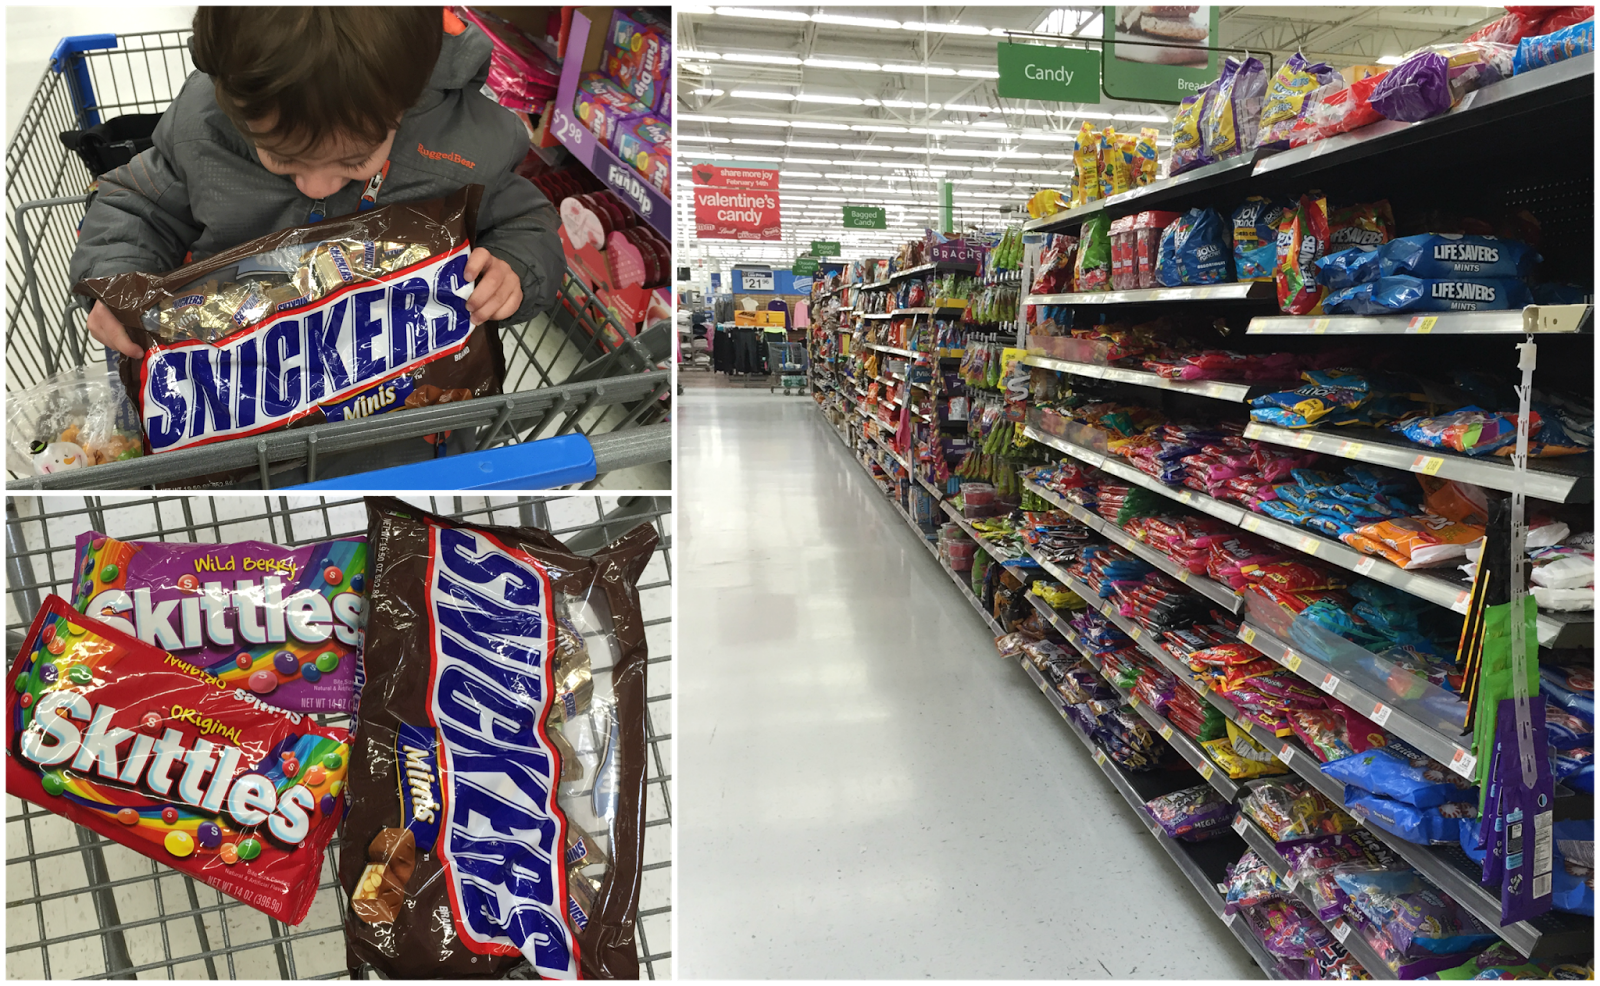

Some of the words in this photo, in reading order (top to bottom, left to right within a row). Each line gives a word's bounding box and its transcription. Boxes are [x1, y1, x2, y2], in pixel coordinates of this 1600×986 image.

[1024, 64, 1074, 86] Candy
[417, 143, 476, 170] RuggedBear
[720, 169, 742, 177] share
[762, 170, 774, 180] joy
[726, 179, 754, 187] February
[698, 192, 776, 209] valentine's
[717, 208, 763, 226] candy
[851, 210, 877, 220] Bagged
[853, 218, 875, 228] Candy
[1434, 244, 1458, 260] LIFE
[1458, 244, 1499, 262] SAVERS
[1453, 263, 1480, 272] MINTS
[1432, 283, 1456, 299] LIFE
[1455, 283, 1496, 302] SAVERS
[1451, 302, 1477, 311] MINTS
[147, 254, 475, 450] SNICKERS
[343, 384, 396, 421] Minis
[85, 576, 361, 651] Skittles
[301, 698, 315, 708] NET
[315, 698, 326, 708] WT
[436, 528, 571, 973] SNICKERS
[21, 691, 315, 844] Skittles
[402, 745, 441, 825] Minis
[1194, 819, 1216, 829] MEGA
[207, 875, 221, 888] NET
[222, 880, 234, 893] WT
[233, 885, 243, 896] 14
[243, 889, 253, 901] OZ
